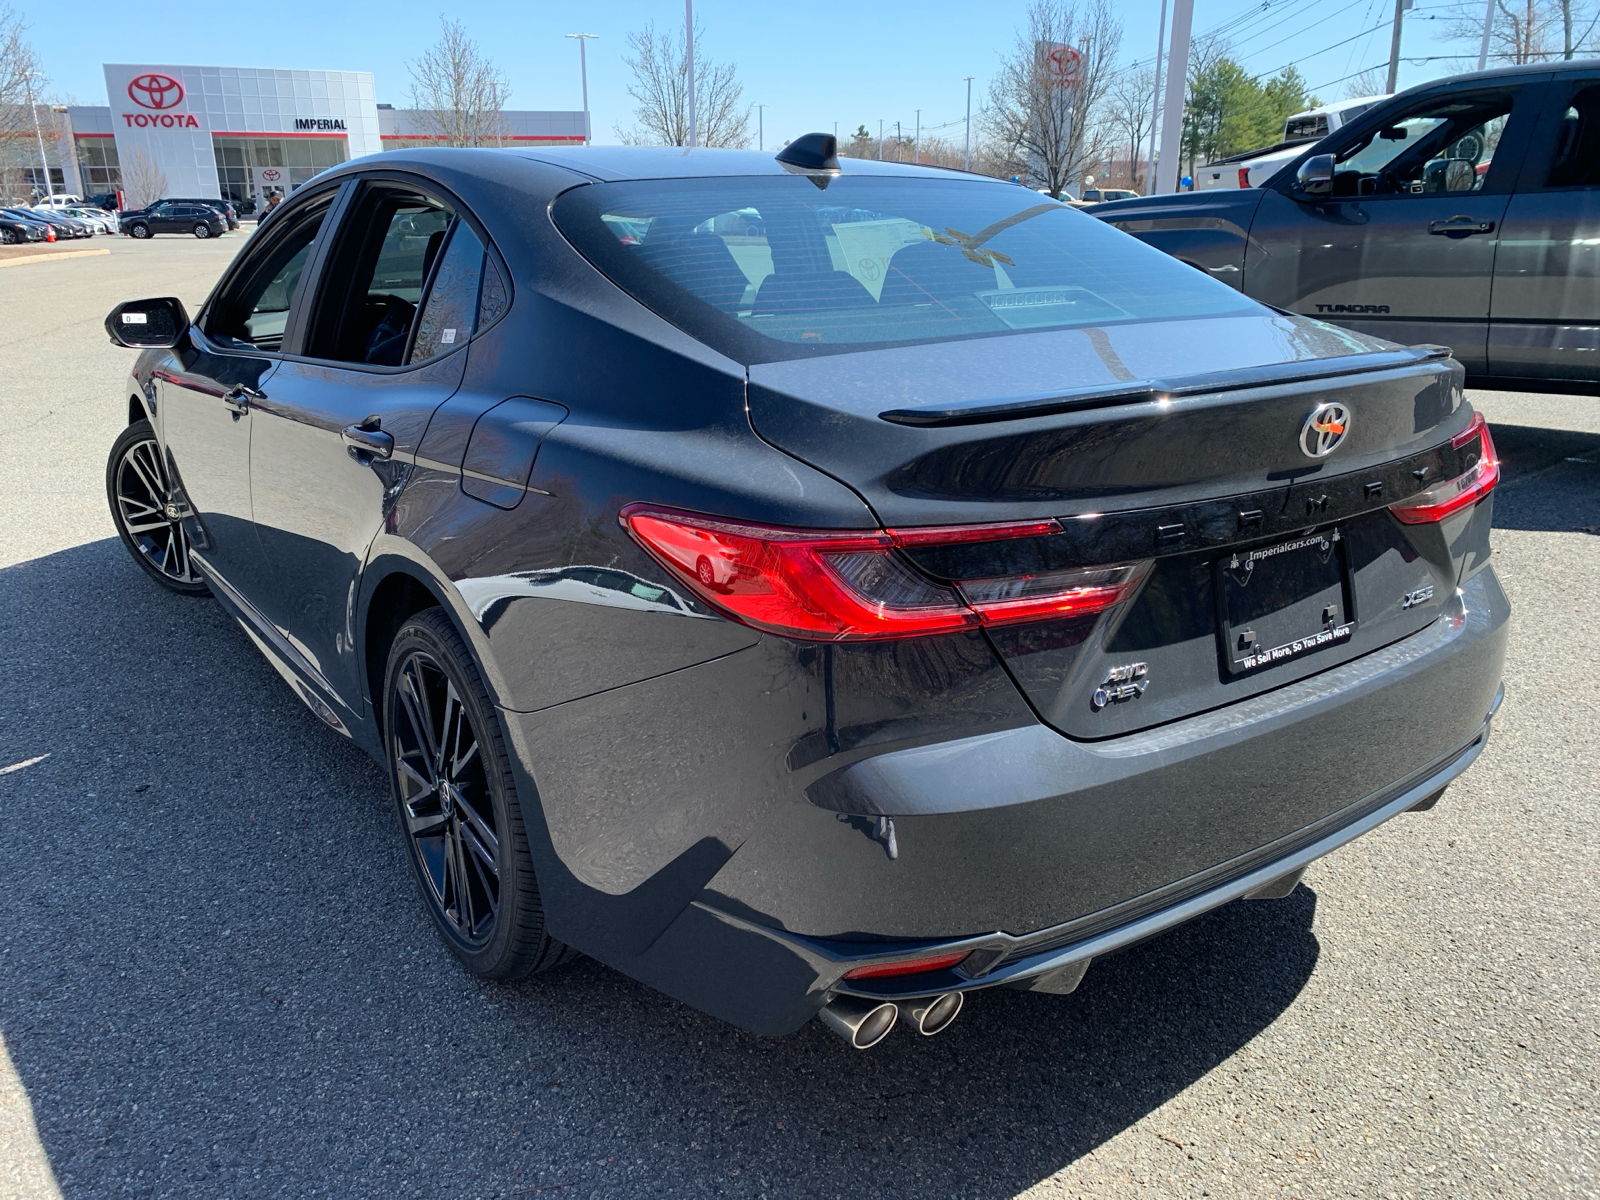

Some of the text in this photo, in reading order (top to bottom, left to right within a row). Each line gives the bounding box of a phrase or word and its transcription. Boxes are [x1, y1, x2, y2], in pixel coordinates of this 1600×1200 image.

[122, 114, 199, 128] TOYOTA
[295, 118, 347, 130] IMPERIAL
[1315, 304, 1390, 314] TUNDRA
[1157, 466, 1429, 540] CAMRY
[1249, 535, 1323, 560] Imperialcars.com
[1402, 585, 1434, 607] XSE
[1243, 627, 1350, 669] We Sell More, So You Save More
[1101, 662, 1149, 684] AWD
[1106, 680, 1150, 702] HEV
